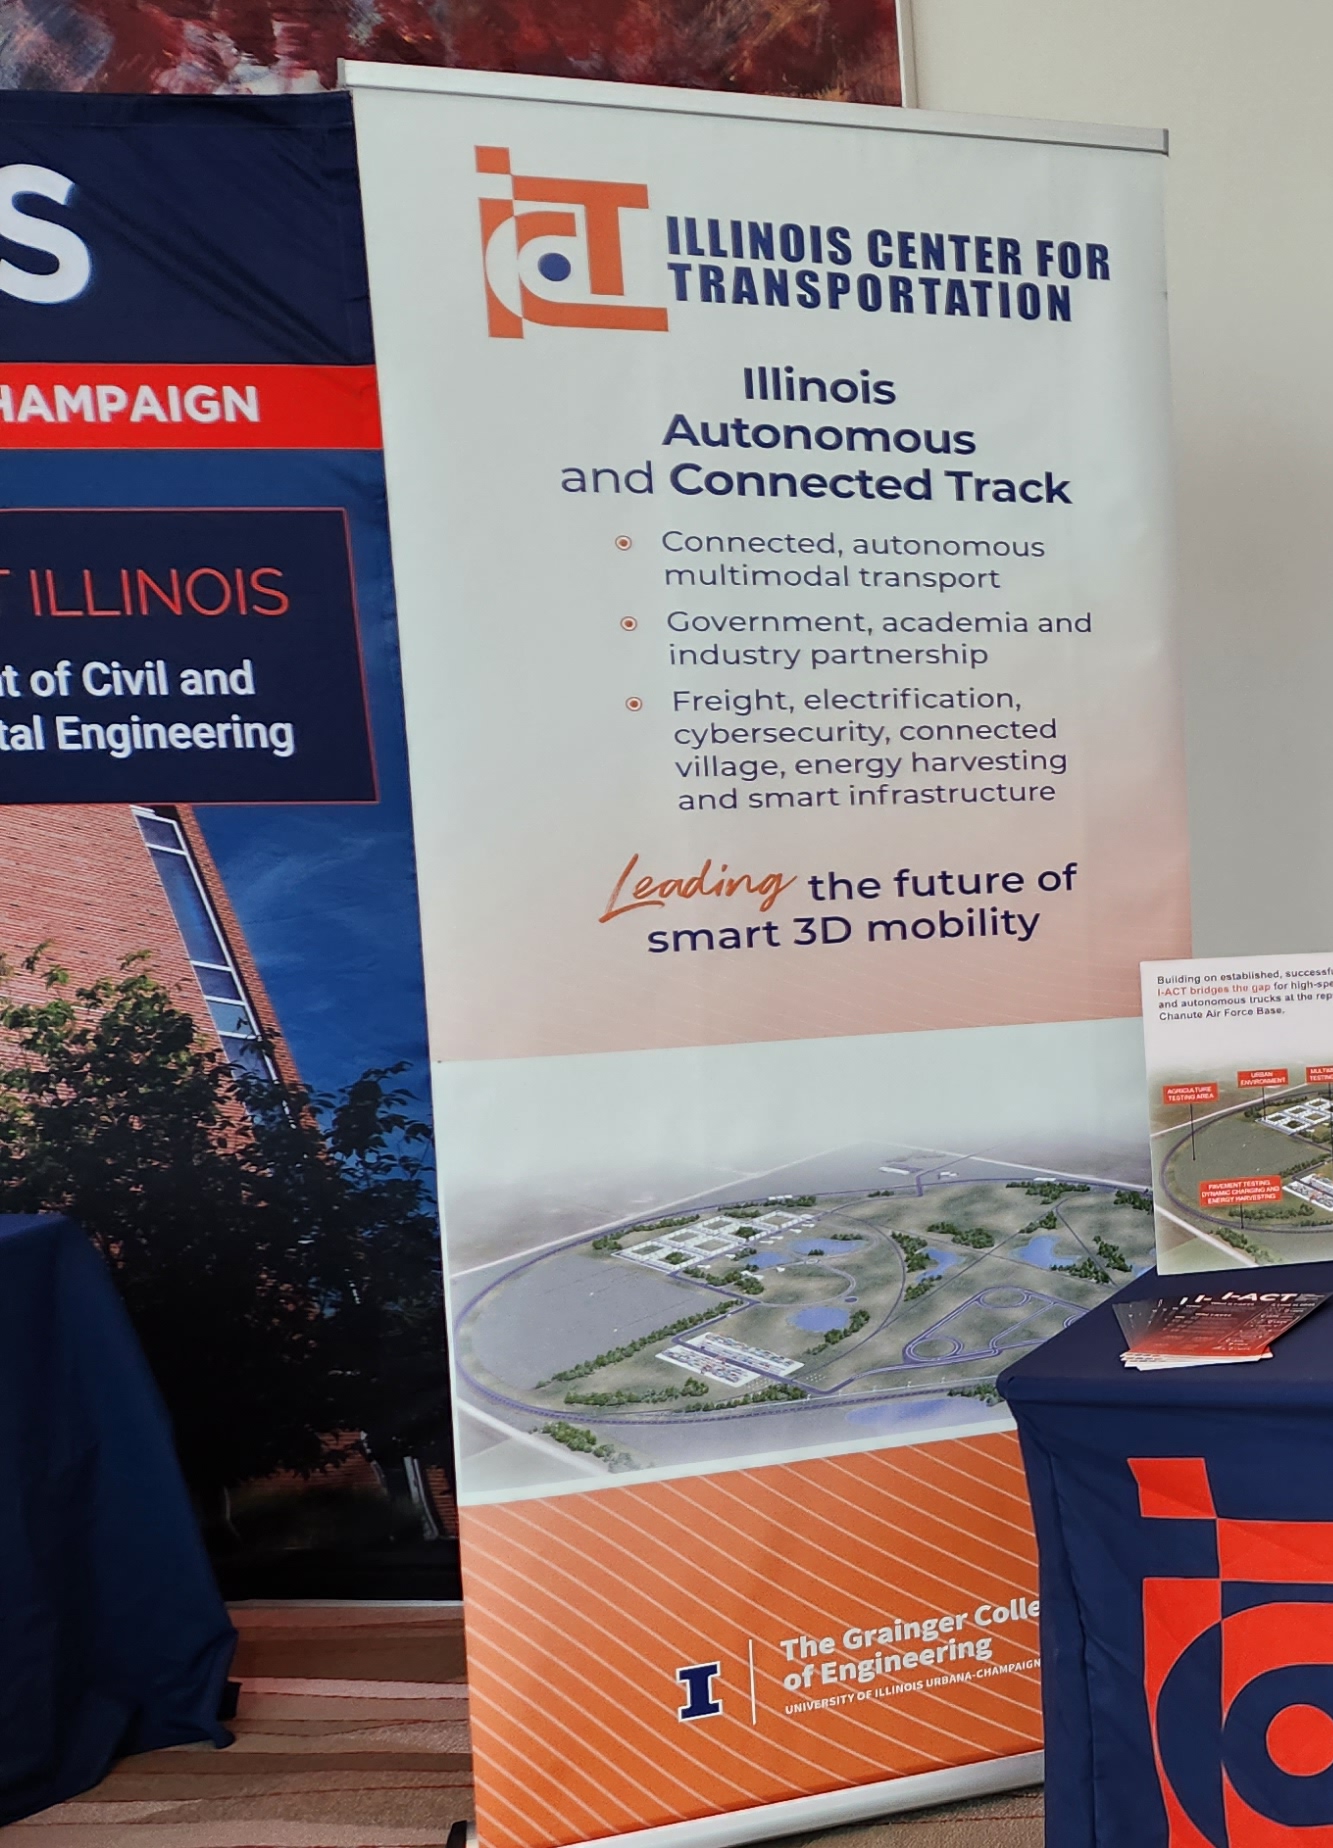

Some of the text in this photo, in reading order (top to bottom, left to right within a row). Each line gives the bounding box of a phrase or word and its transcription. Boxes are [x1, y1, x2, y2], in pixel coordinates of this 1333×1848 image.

[0, 164, 92, 304] S
[666, 216, 1111, 281] ILLINOIS CENTER FOR
[667, 262, 1072, 322] TRANSPORTATION
[744, 366, 896, 405] Illinois
[662, 414, 976, 455] Autonomous
[562, 461, 1072, 504] and Connected Track
[663, 531, 1044, 557] Connected, autonomous
[30, 566, 290, 619] ILLINOIS
[666, 564, 1000, 592] multimodal transport
[668, 612, 1091, 635] Government, academia and
[670, 644, 987, 669] industry partnership
[30, 660, 72, 697] of
[82, 660, 168, 696] Civil
[180, 659, 255, 695] and
[674, 687, 1020, 716] Freight, electrification,
[56, 714, 294, 758] Engineering
[675, 718, 1056, 749] cybersecurity, connected
[676, 750, 1066, 781] village, energy harvesting
[679, 784, 1055, 810] and smart infrastructure
[599, 853, 1077, 924] Leading the future of
[648, 907, 1040, 952] smart 3D mobility
[1190, 984, 1229, 996] bridges
[780, 1598, 1040, 1662] The Grainger Colle
[782, 1635, 992, 1692] of Engineering
[785, 1658, 1041, 1715] UNIVERSITY OF ILLINOIS URBANA-CHAMPAIGN
